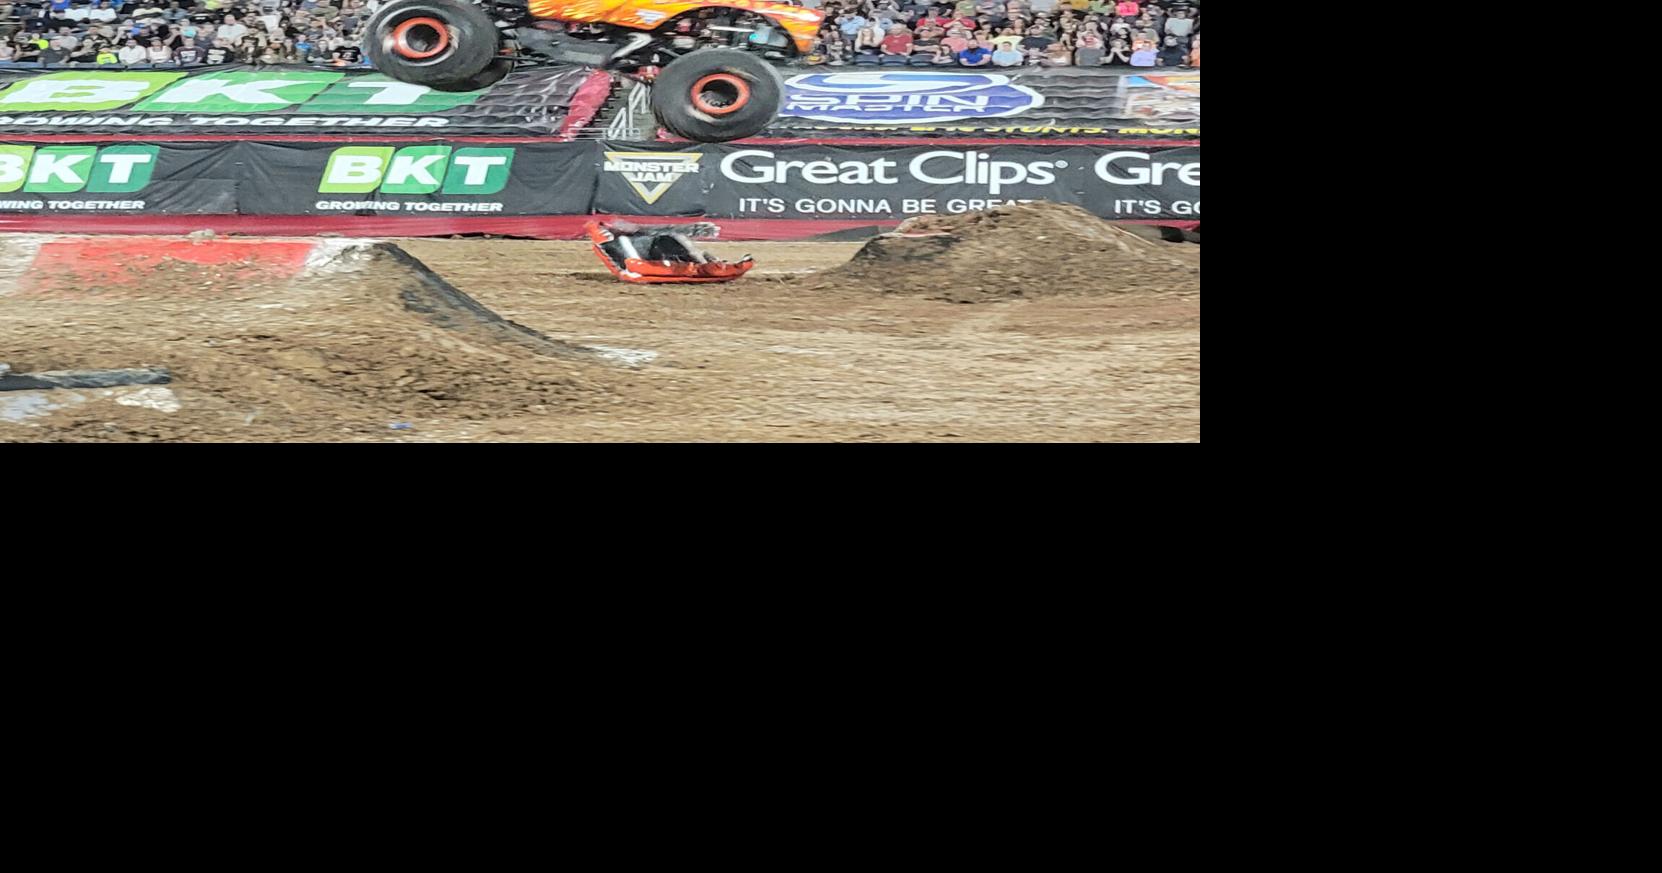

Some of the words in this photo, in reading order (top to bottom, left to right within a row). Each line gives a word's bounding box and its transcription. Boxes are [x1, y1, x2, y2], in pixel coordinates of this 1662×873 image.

[1, 79, 432, 106] BKT
[788, 94, 990, 107] SPIN
[190, 116, 450, 127] TOGETHER
[327, 154, 507, 186] BKT
[604, 161, 699, 173] MONSTER
[720, 150, 898, 185] Great
[631, 172, 675, 183] JAM
[48, 200, 145, 210] TOGETHER
[315, 201, 399, 211] GROWING
[404, 201, 503, 212] TOGETHER
[739, 198, 785, 213] IT'S
[795, 198, 892, 213] GONNA
[902, 199, 937, 213] BE
[946, 199, 1033, 213] GREA
[1114, 200, 1162, 215] IT'S
